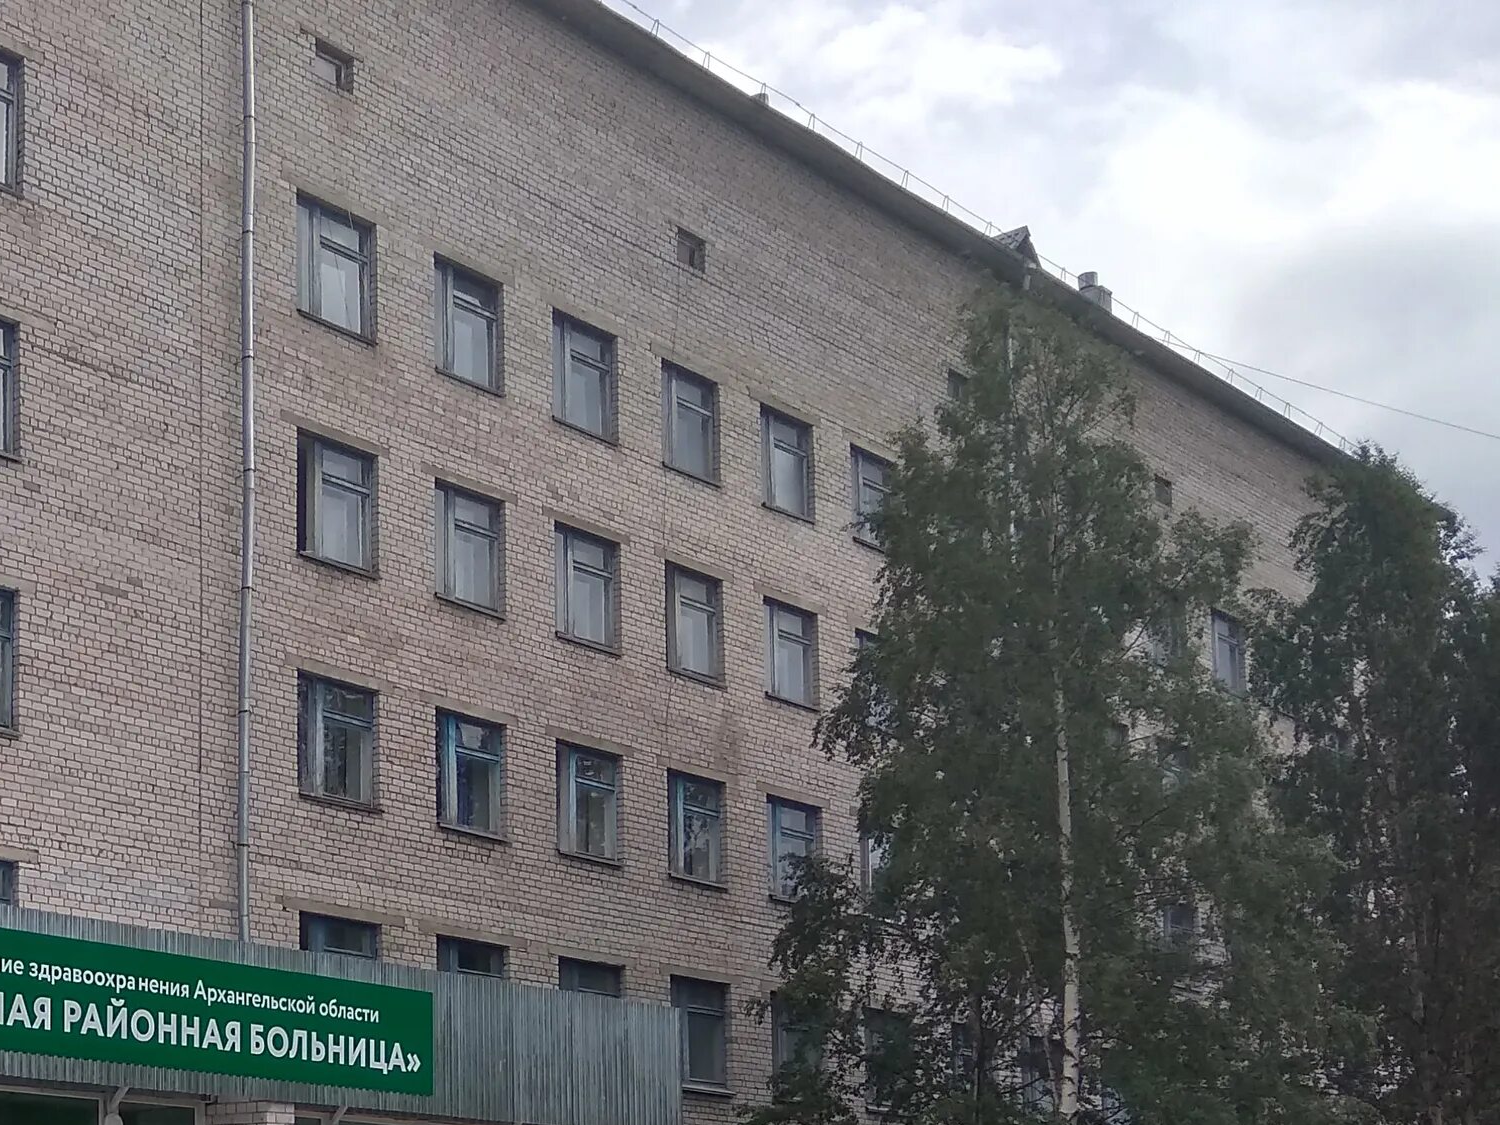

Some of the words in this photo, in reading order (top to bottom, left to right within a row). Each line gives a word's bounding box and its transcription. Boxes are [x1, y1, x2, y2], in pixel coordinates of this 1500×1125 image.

[193, 979, 316, 1020] Архангельской
[318, 998, 379, 1024] области
[63, 997, 241, 1053] РАЙОННАЯ
[250, 1023, 421, 1075] БОЛЬНИЦА»
